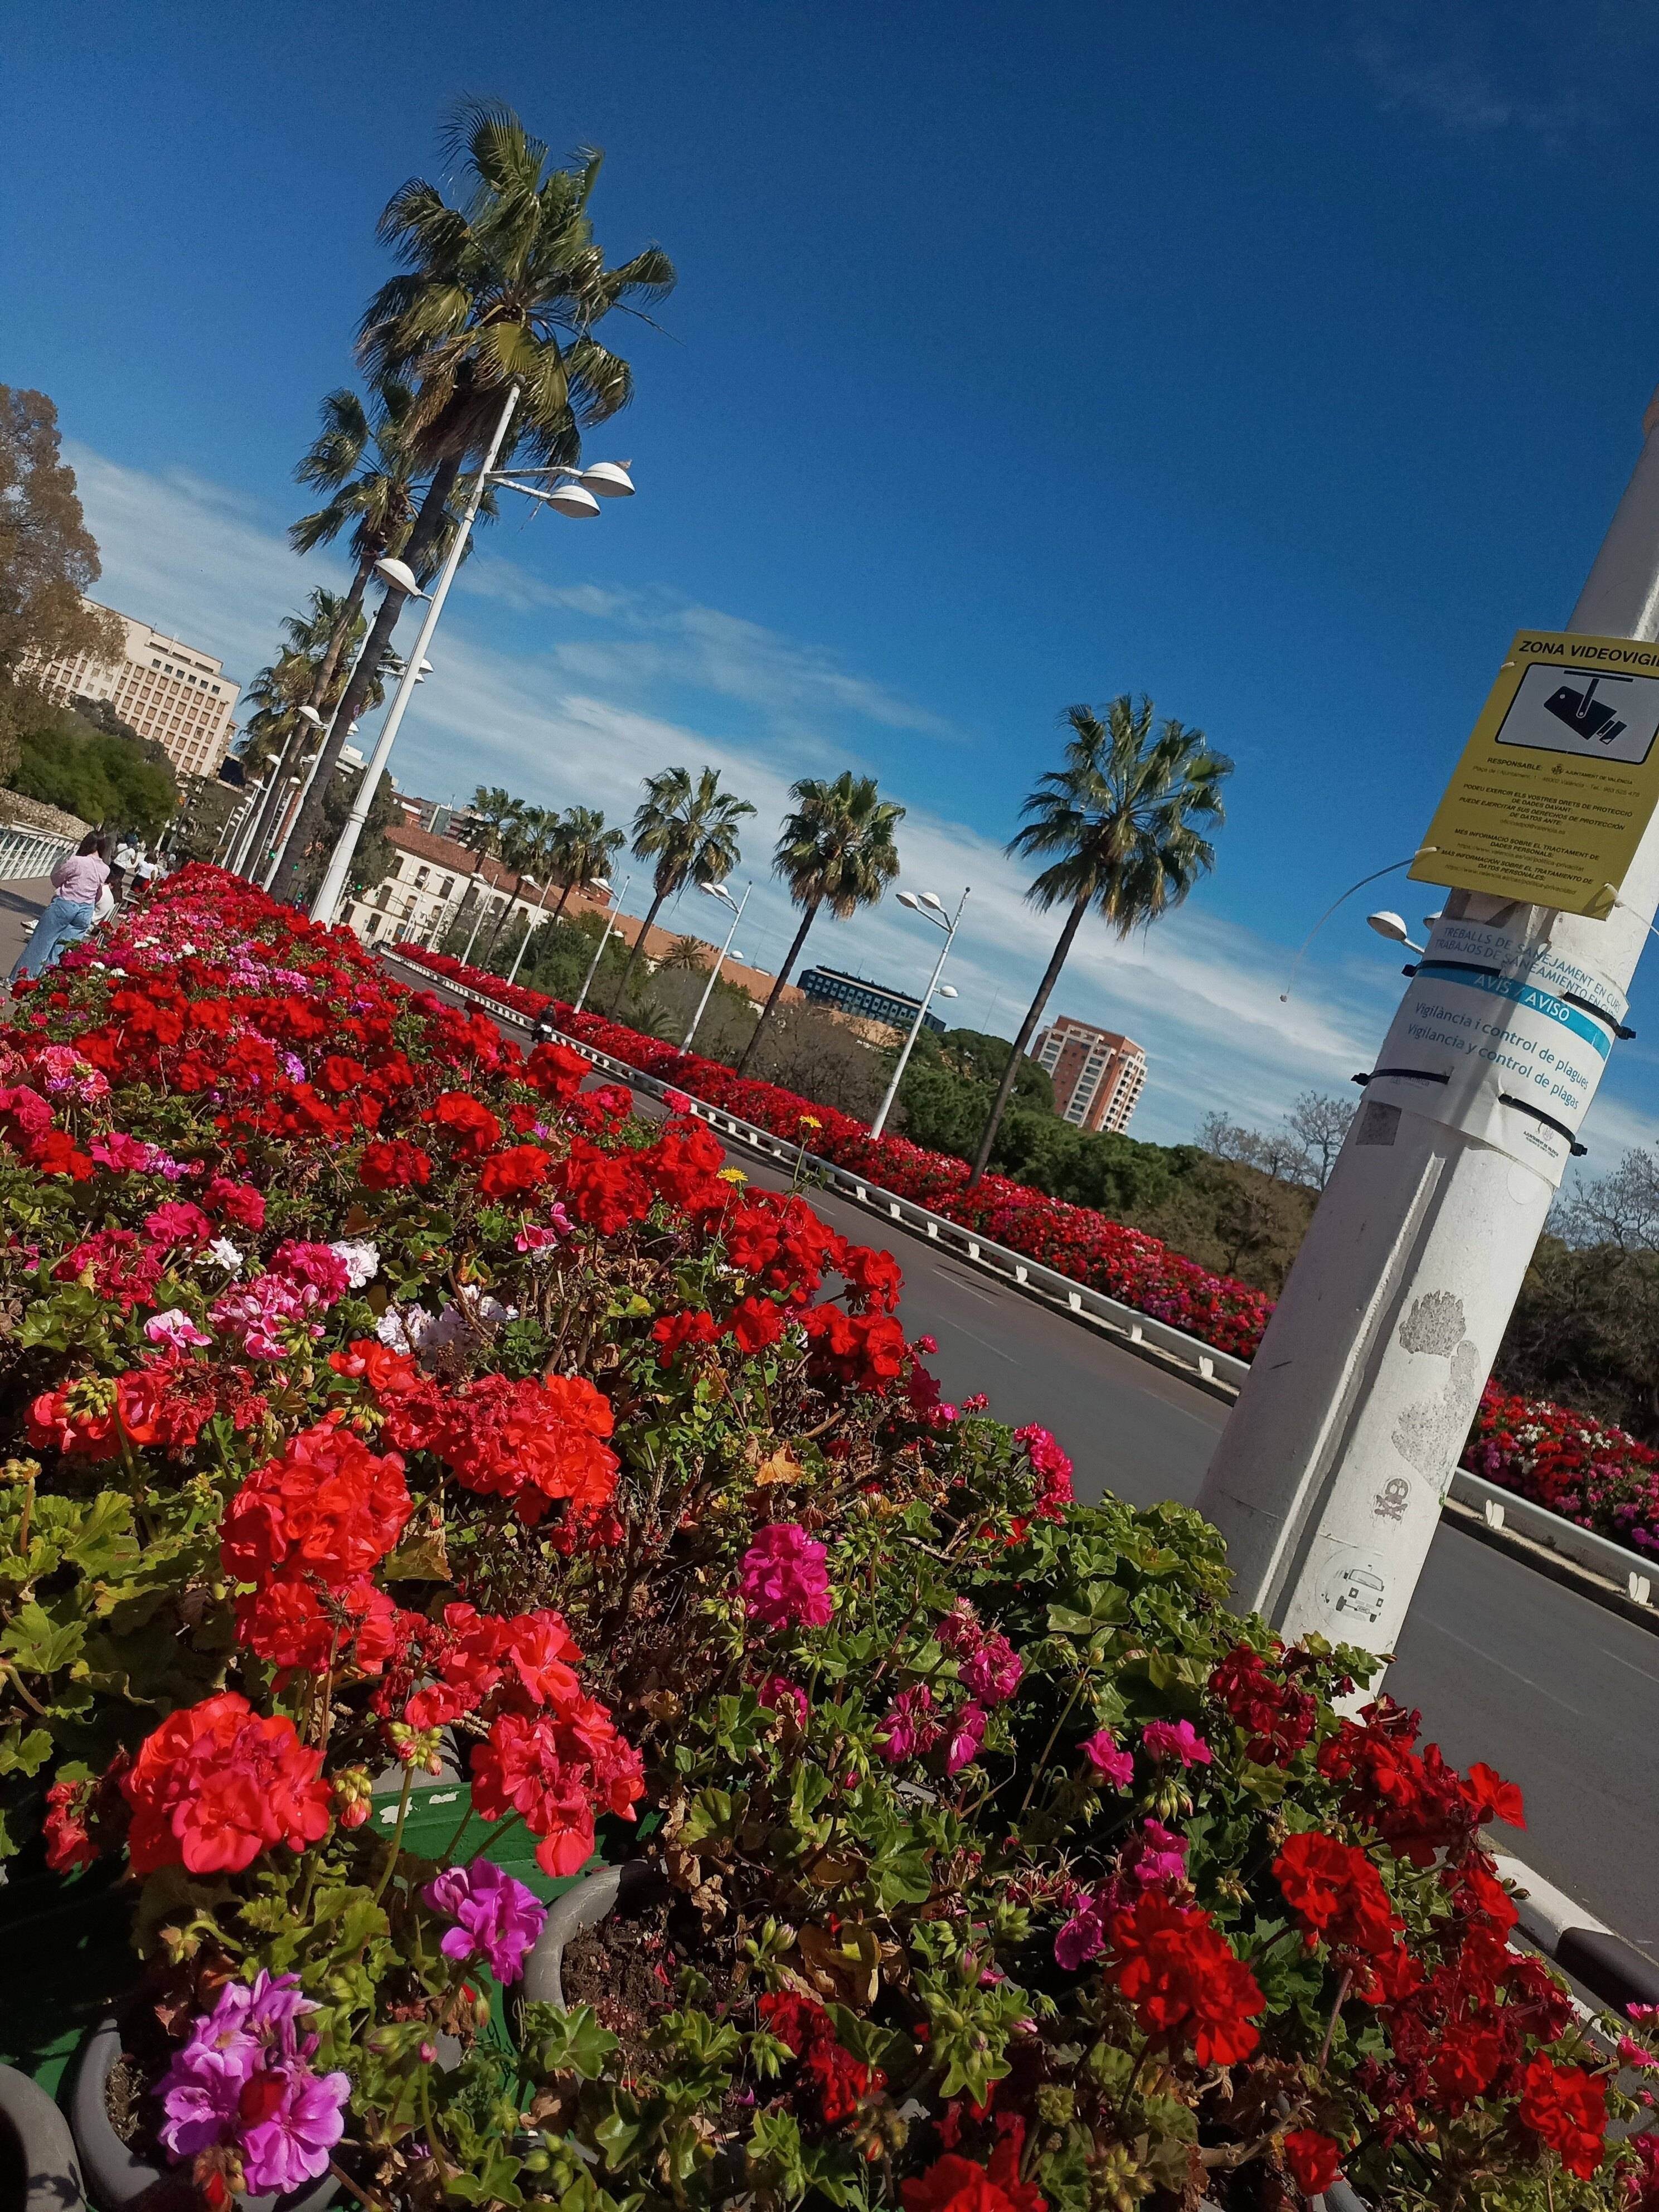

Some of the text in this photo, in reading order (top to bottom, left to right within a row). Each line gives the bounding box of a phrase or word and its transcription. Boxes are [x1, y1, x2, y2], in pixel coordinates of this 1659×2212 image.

[1519, 641, 1659, 667] ZONA VIDEOVIGI
[1487, 758, 1543, 770] RESPONSABLE:
[1459, 797, 1481, 805] PUEDE
[1481, 800, 1516, 811] EJERCITAR
[1531, 809, 1568, 820] DERECHOS
[1579, 818, 1626, 830] PROTECCIÓN
[1486, 788, 1514, 796] EXERCIR
[1528, 794, 1556, 803] VOSTRES
[1559, 799, 1580, 808] DRETS
[1592, 806, 1633, 817] PROTECCIÓ
[1521, 799, 1544, 808] DADES
[1520, 814, 1542, 822] DATOS
[1469, 831, 1509, 842] INFORMACIÓ
[1510, 838, 1532, 847] SOBRE
[1543, 845, 1589, 858] TRACTAMENT
[1456, 853, 1501, 865] INFORMACIÓN
[1501, 861, 1523, 869] SOBRE
[1534, 867, 1582, 881] TRATAMIENTO
[1500, 867, 1545, 881] PERSONALES:
[1435, 938, 1600, 1007] TRABAJOS DE SANEAMIENTO EN
[1444, 927, 1492, 944] TREBALLS
[1495, 937, 1513, 950] DE
[1516, 943, 1594, 987] SANEJAMENT
[1594, 982, 1607, 998] EN
[1514, 987, 1525, 997] /
[1525, 992, 1570, 1021] AVISO
[1415, 1002, 1589, 1090] Vigilància i control de plagues
[1408, 1023, 1579, 1110] Vigilancia y control de plagas
